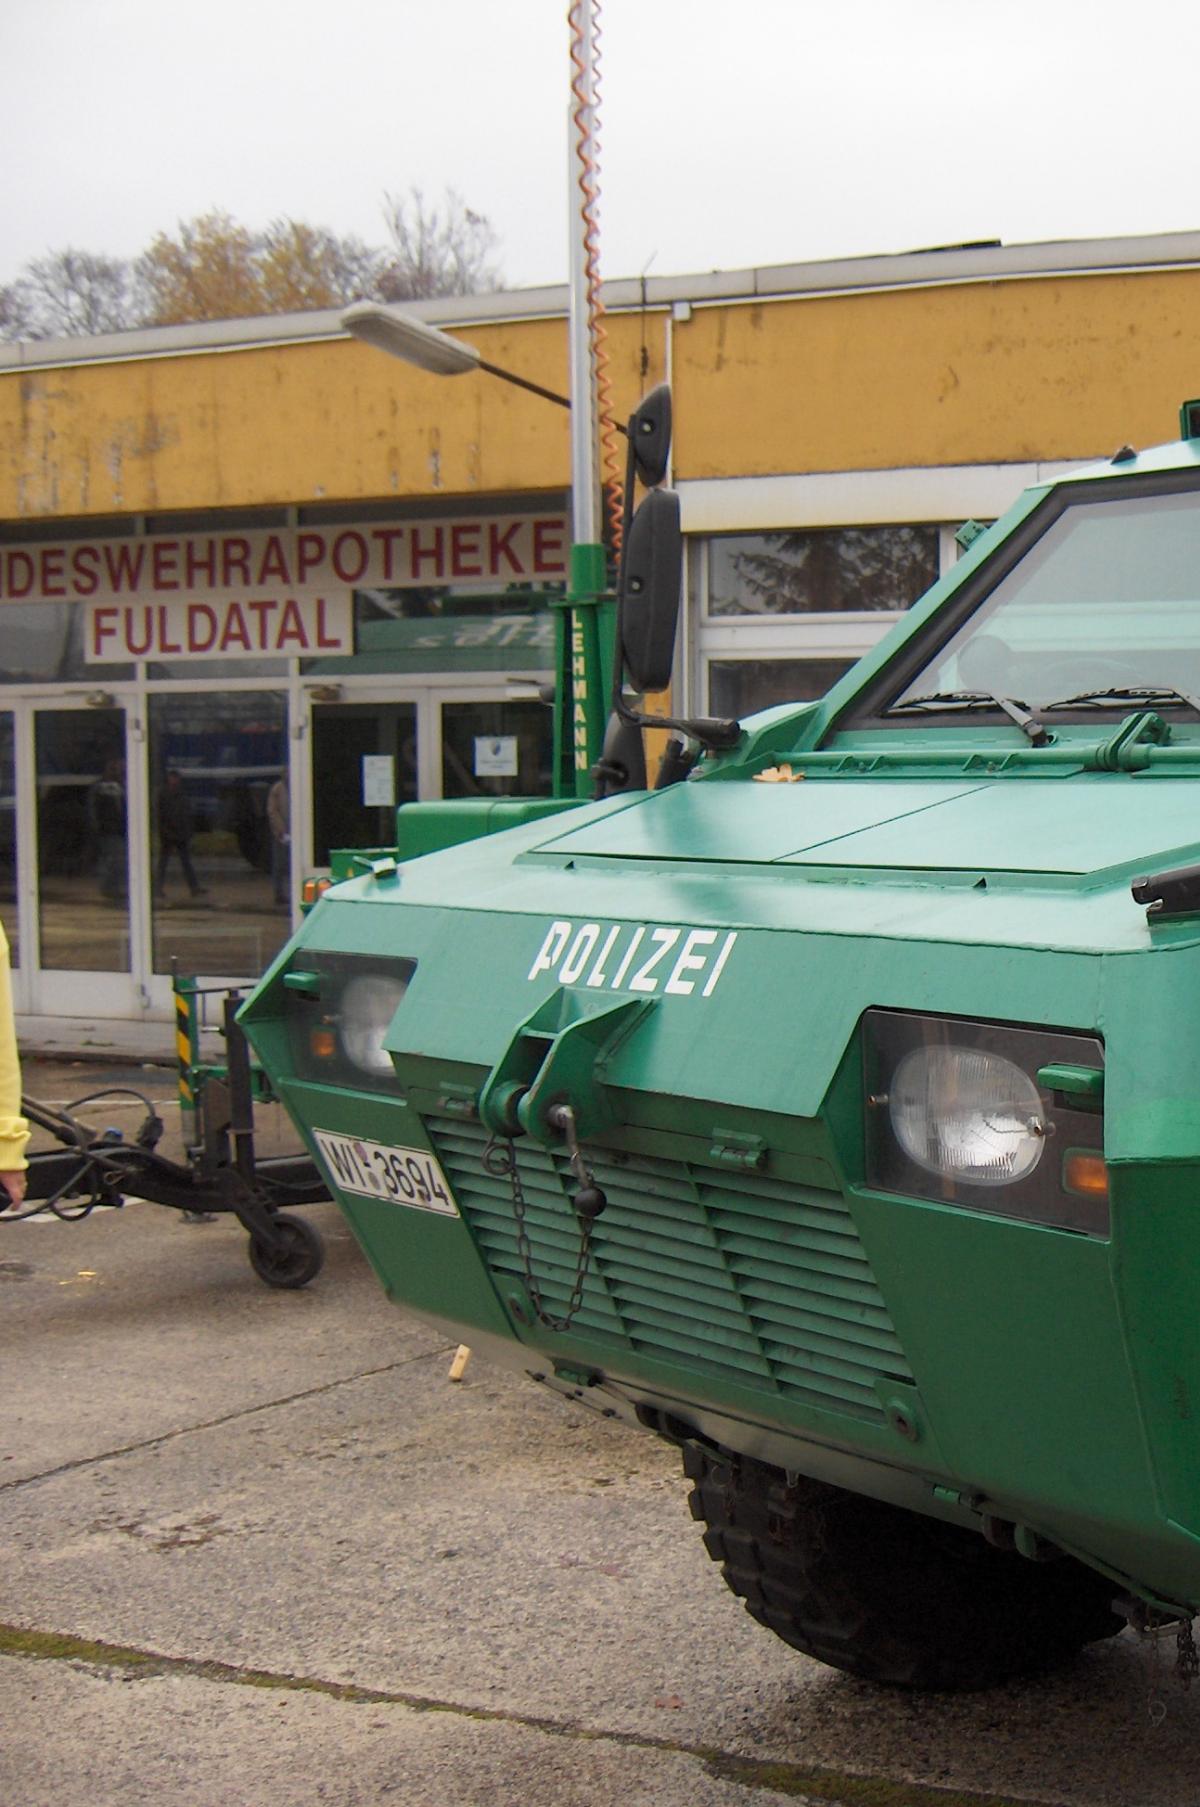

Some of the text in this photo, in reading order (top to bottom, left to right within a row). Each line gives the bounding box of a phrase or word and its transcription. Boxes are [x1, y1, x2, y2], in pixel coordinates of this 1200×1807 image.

[0, 520, 566, 599] DESWEHRAPOTHEKE
[93, 599, 342, 656] FULDATAL
[571, 608, 588, 771] LEHMANN
[527, 920, 738, 997] POLIZEI
